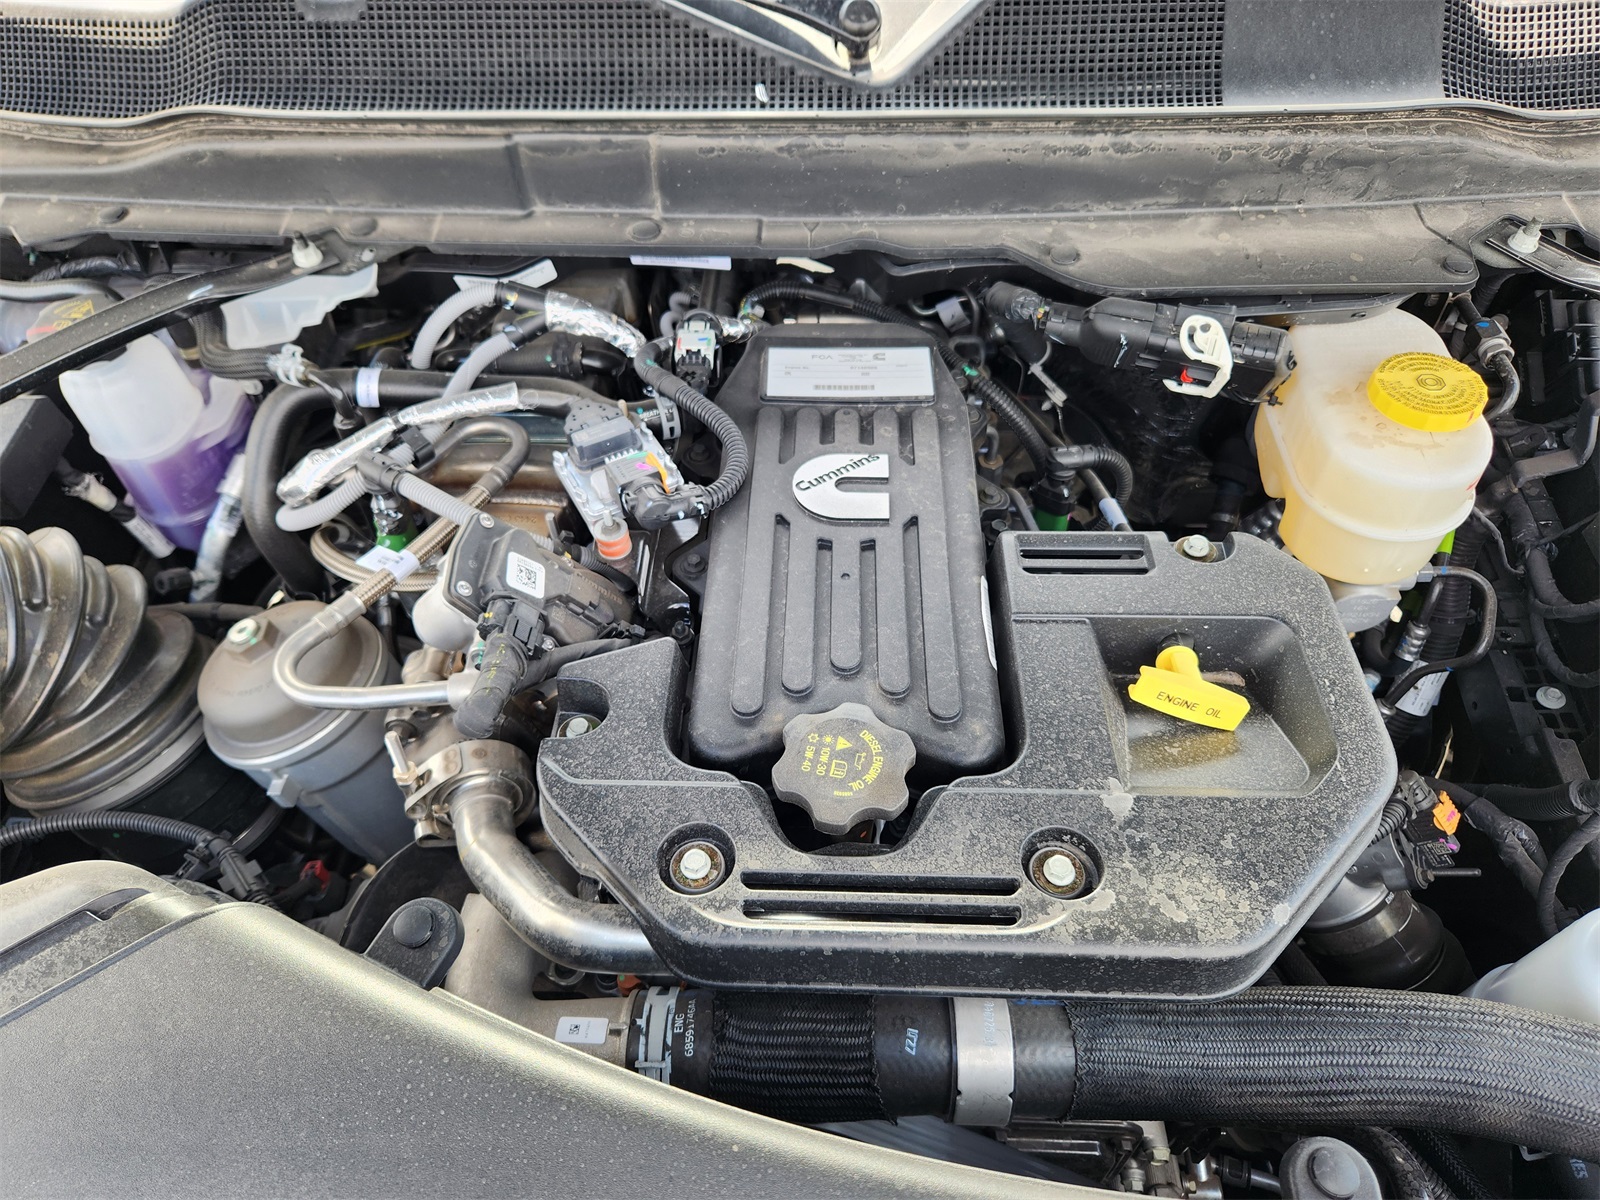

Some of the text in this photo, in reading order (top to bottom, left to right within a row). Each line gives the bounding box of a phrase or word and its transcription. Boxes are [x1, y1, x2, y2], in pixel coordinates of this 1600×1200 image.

[795, 453, 880, 492] Cummins
[1156, 691, 1221, 719] ENGINE OIL
[801, 745, 816, 772] 5W-40
[816, 747, 830, 776] 10W-30
[848, 730, 883, 791] DIESEL ENGINE OIL
[673, 1012, 685, 1033] ENG
